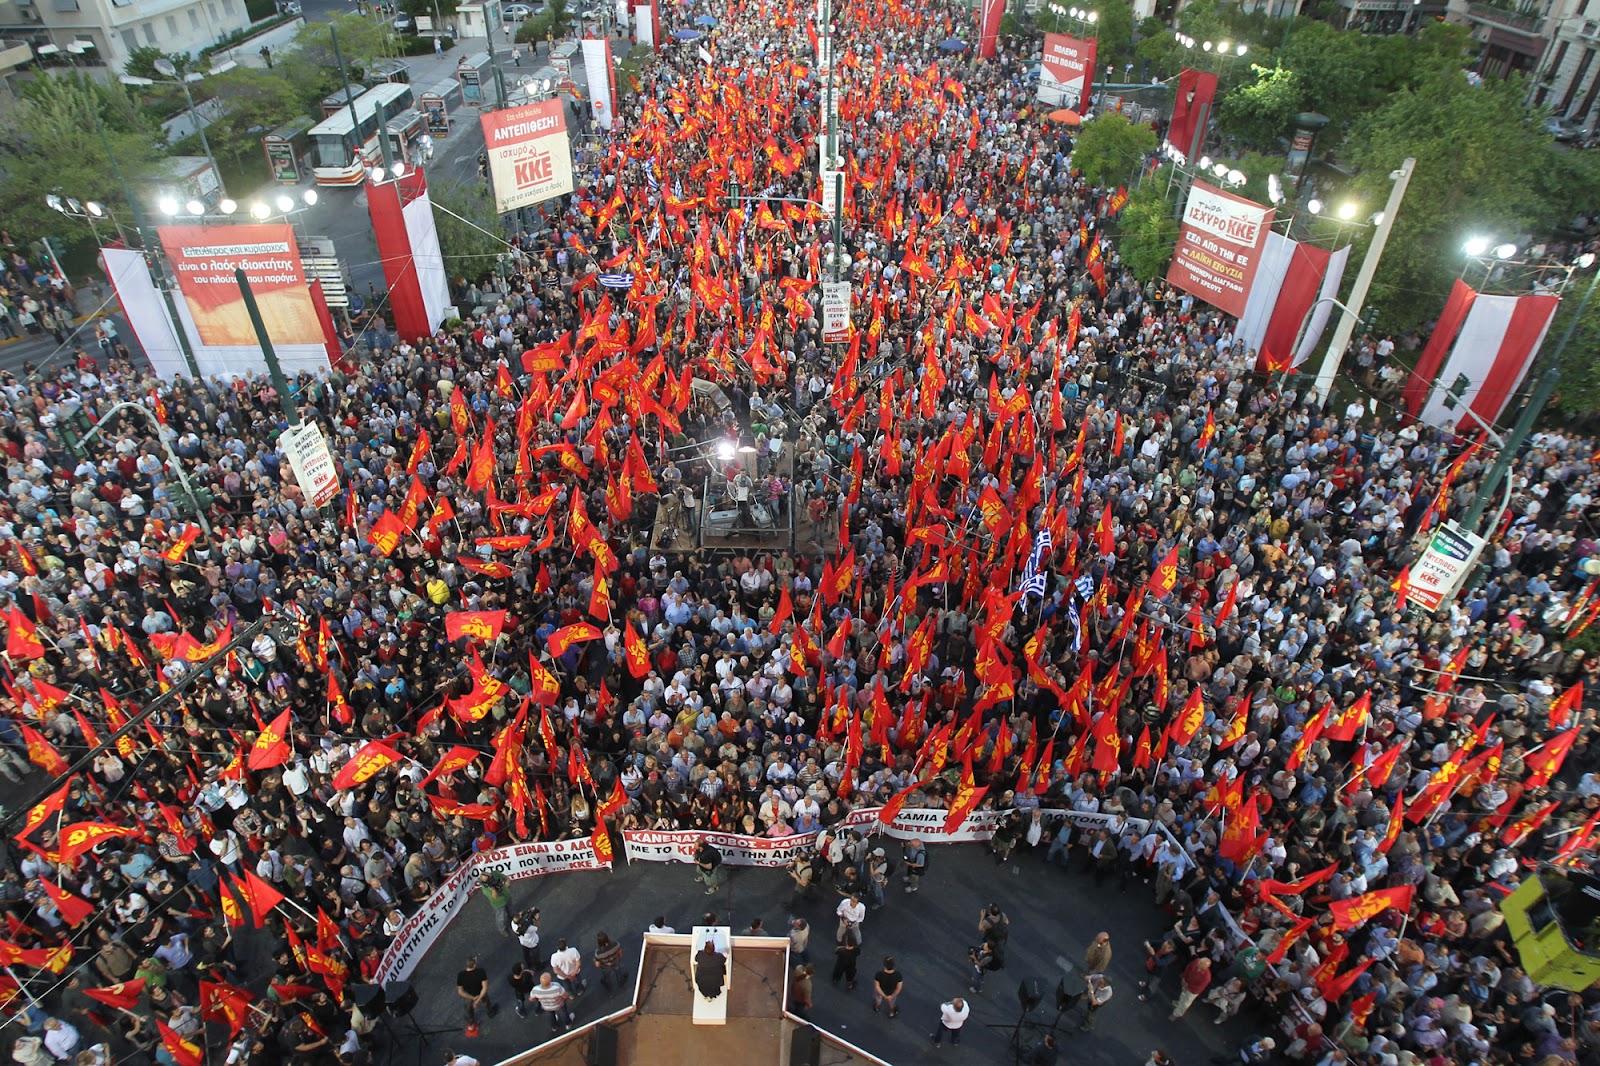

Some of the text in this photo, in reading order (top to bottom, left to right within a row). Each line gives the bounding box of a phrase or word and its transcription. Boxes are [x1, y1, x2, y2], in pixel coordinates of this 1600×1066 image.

[500, 143, 528, 159] ισχυρό
[514, 156, 553, 185] ΚΚΕ
[1189, 207, 1256, 241] ΙΣΧΥΡΟ ΚΚΕ
[184, 244, 286, 257] Ελεύθερος και κυρίαρχος
[1186, 231, 1248, 266] ΕΞΩ ΑΠΟ ΤΗΝ ΕΕ
[178, 263, 198, 271] είναι
[210, 259, 236, 272] λαός
[238, 257, 294, 271] ιδιοκτήτης
[1212, 261, 1243, 280] ΕΞΟΥΣΙΑ
[193, 276, 208, 284] του
[210, 273, 238, 284] πλούτο
[264, 272, 298, 284] παράγει
[1189, 274, 1201, 284] ΤΟΥ
[314, 473, 328, 486] ΚΚΕ
[1420, 573, 1440, 586] ΚΚΕ
[891, 823, 948, 834] ΜΕΤΩΠ
[631, 833, 700, 843] ΚΑΝΕΝΑΣ
[705, 835, 757, 848] ΦΟΒΟΣ
[631, 844, 649, 853] ΜΕ
[677, 845, 697, 855] ΚΚ
[740, 851, 767, 859] ΤΗΝ
[508, 866, 549, 880] ΤΙΚΗΣ
[568, 860, 593, 869] ΚΚΕ
[376, 840, 593, 984] ΕΛΕΥΘΕΡΟΣ ΚΑΙ ΚΥΡΙΑΡΧΟΣ ΕΙΝΑΙ Ο ΛΑΟ
[387, 913, 439, 982] ΔΙΟΚΤΗΤΗΣ
[441, 893, 458, 913] ΤΟΥ
[519, 857, 540, 868] ΠΟΥ
[546, 850, 594, 863] ΠΑΡΑΓΕ
